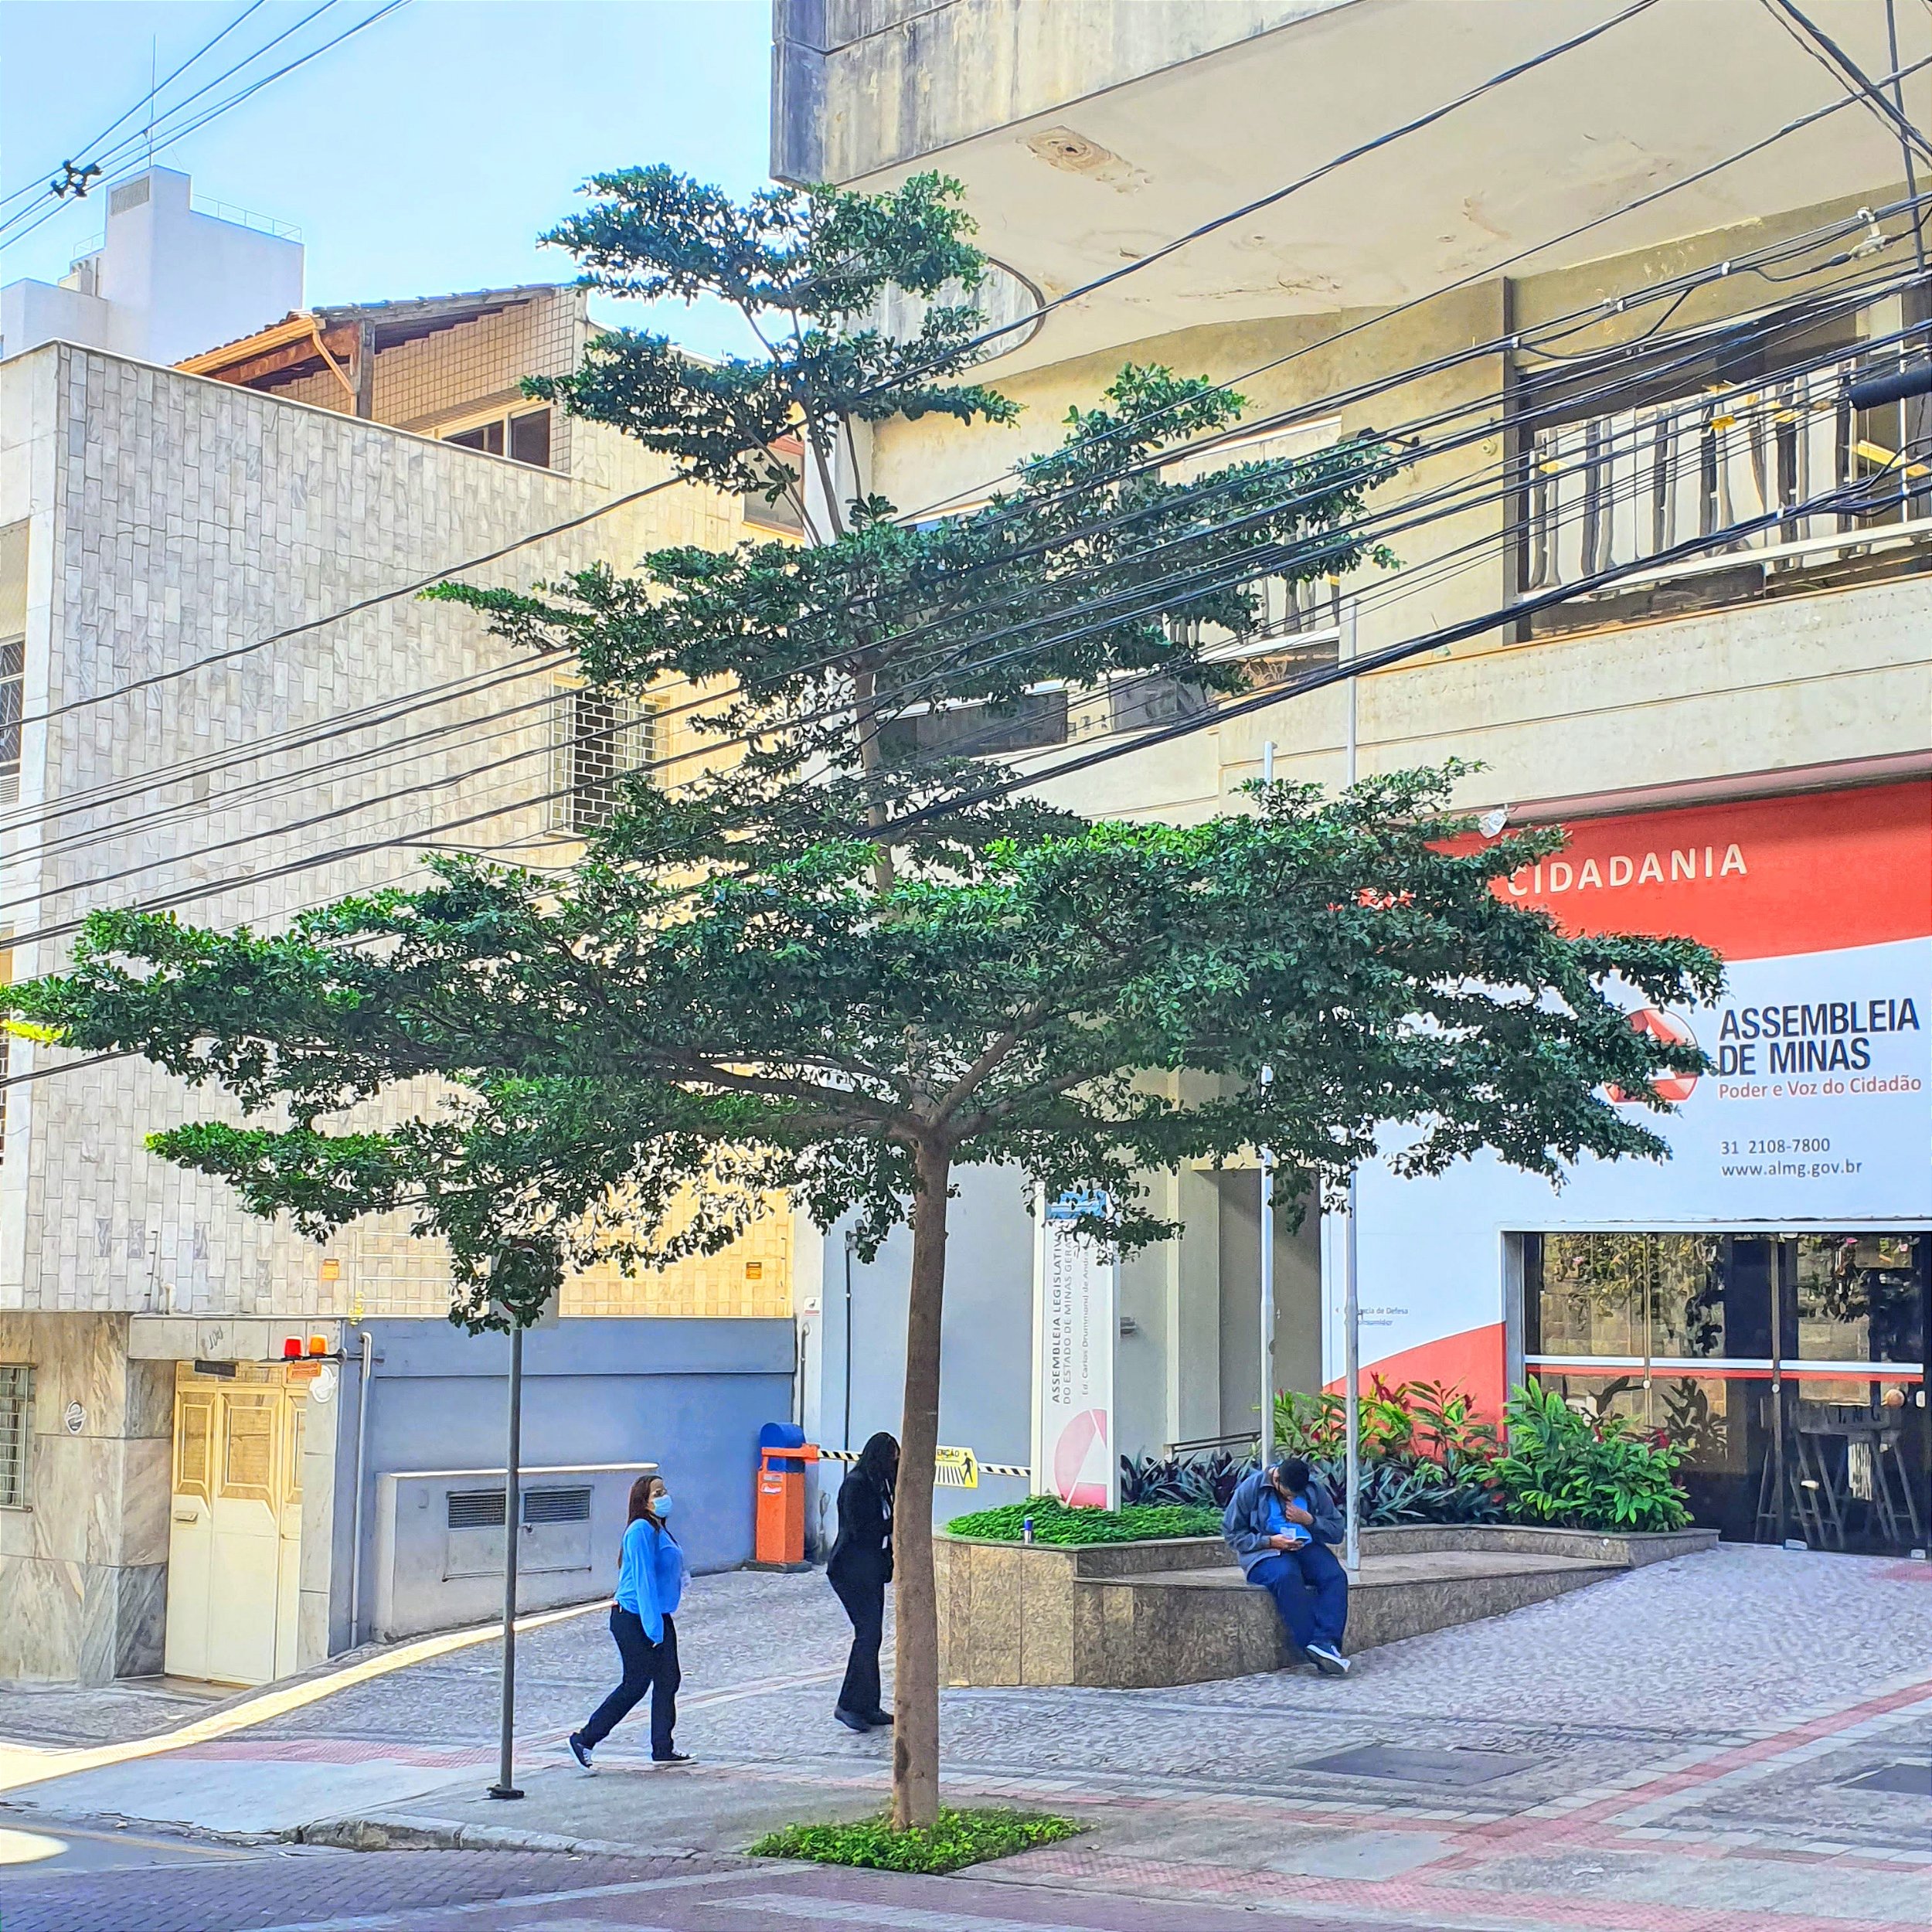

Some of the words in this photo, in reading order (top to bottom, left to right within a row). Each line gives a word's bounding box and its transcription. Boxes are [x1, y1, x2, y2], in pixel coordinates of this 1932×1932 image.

[1507, 842, 1748, 896] CIDADANIA
[1719, 998, 1920, 1041] ASSEMBLEIA
[1719, 1044, 1756, 1077] DE
[1770, 1037, 1871, 1074] MINAS
[1719, 1082, 1767, 1099] Poder
[1773, 1085, 1782, 1097] e
[1787, 1081, 1817, 1096] Voz
[1823, 1078, 1845, 1094] do
[1850, 1074, 1921, 1094] Cidadão
[1721, 1141, 1739, 1155] 31
[1748, 1138, 1831, 1154] 2108-7800
[1722, 1158, 1862, 1178] www.almg.gov.br
[1064, 1319, 1071, 1334] DE
[1052, 1317, 1061, 1403] ASSEMBLEIA
[1063, 1386, 1071, 1405] DO
